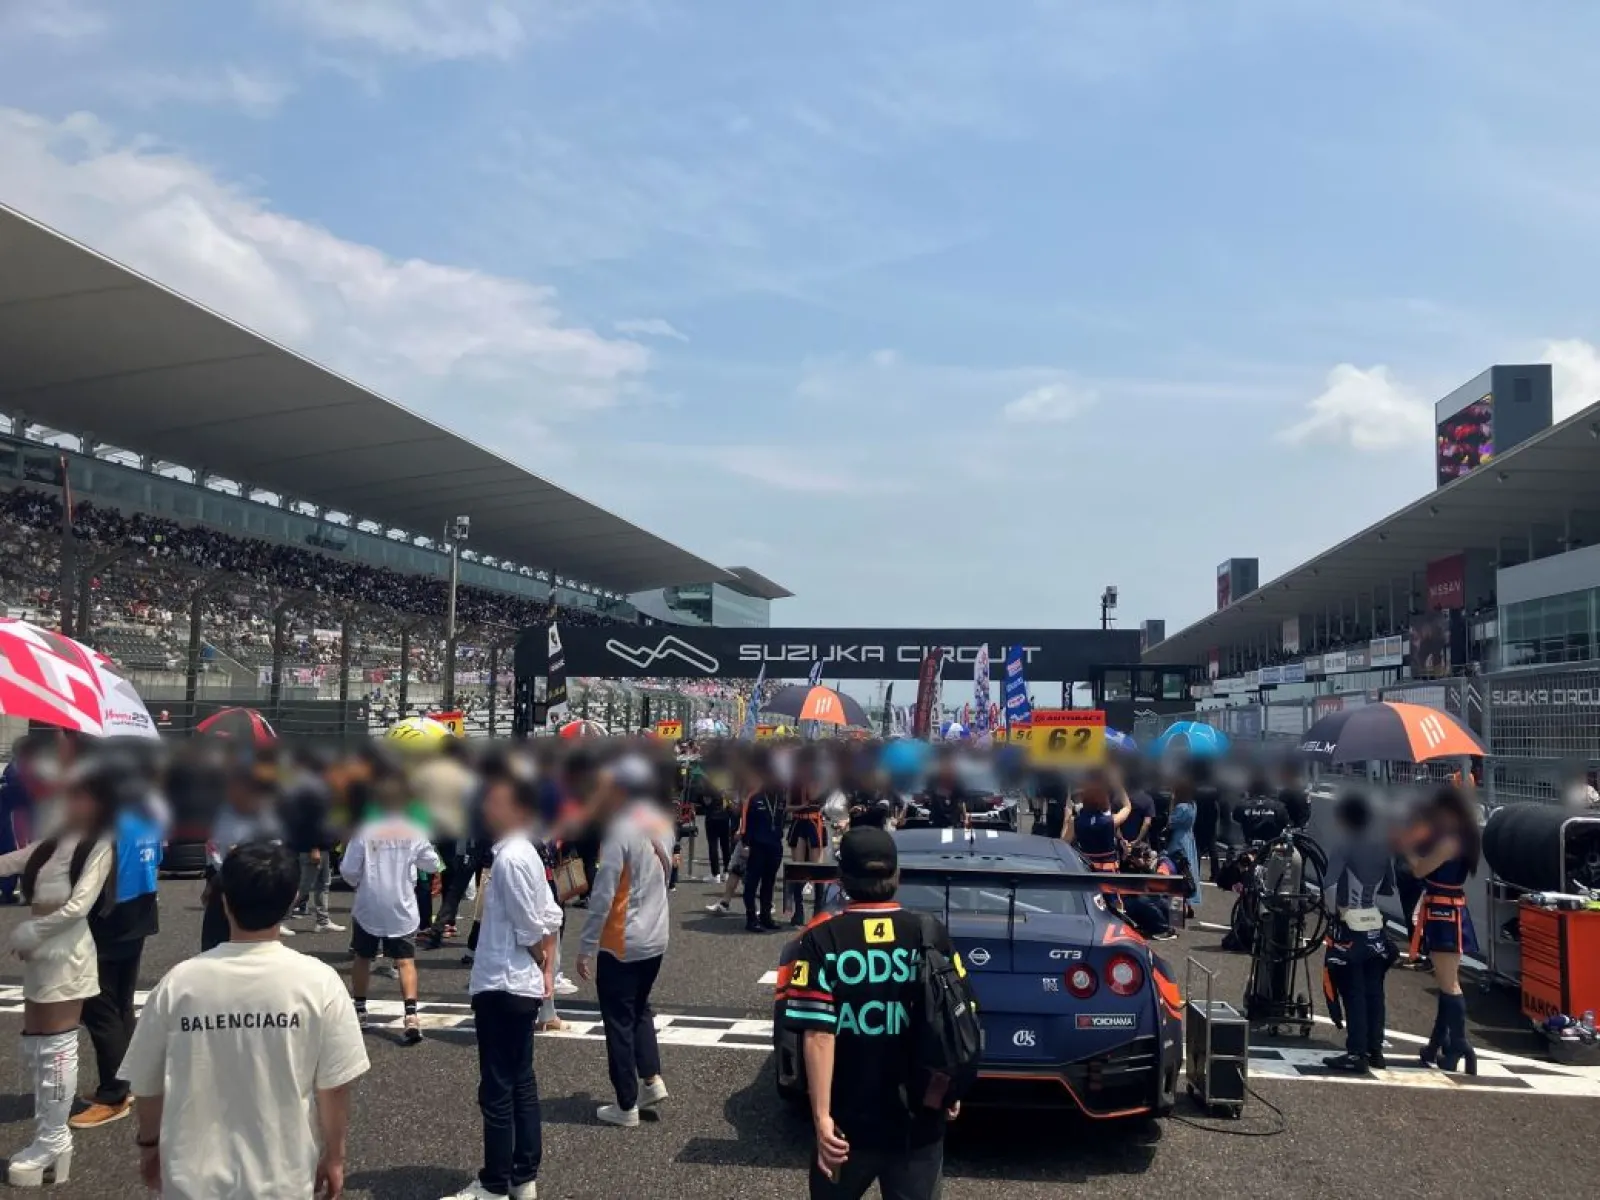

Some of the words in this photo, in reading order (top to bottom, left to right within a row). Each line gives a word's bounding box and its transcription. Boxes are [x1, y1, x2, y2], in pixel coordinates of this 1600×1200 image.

[1430, 579, 1464, 598] NISSAN
[739, 644, 885, 662] SUZUKA
[897, 645, 1042, 663] CIRCUT
[1492, 690, 1549, 706] SUZUKA
[1048, 728, 1092, 752] 62
[873, 923, 885, 938] 4
[1049, 949, 1082, 959] GT3
[181, 1012, 301, 1032] BALENCIAGA
[837, 1001, 910, 1035] ACIN
[1092, 1017, 1132, 1026] YOKOHAMA
